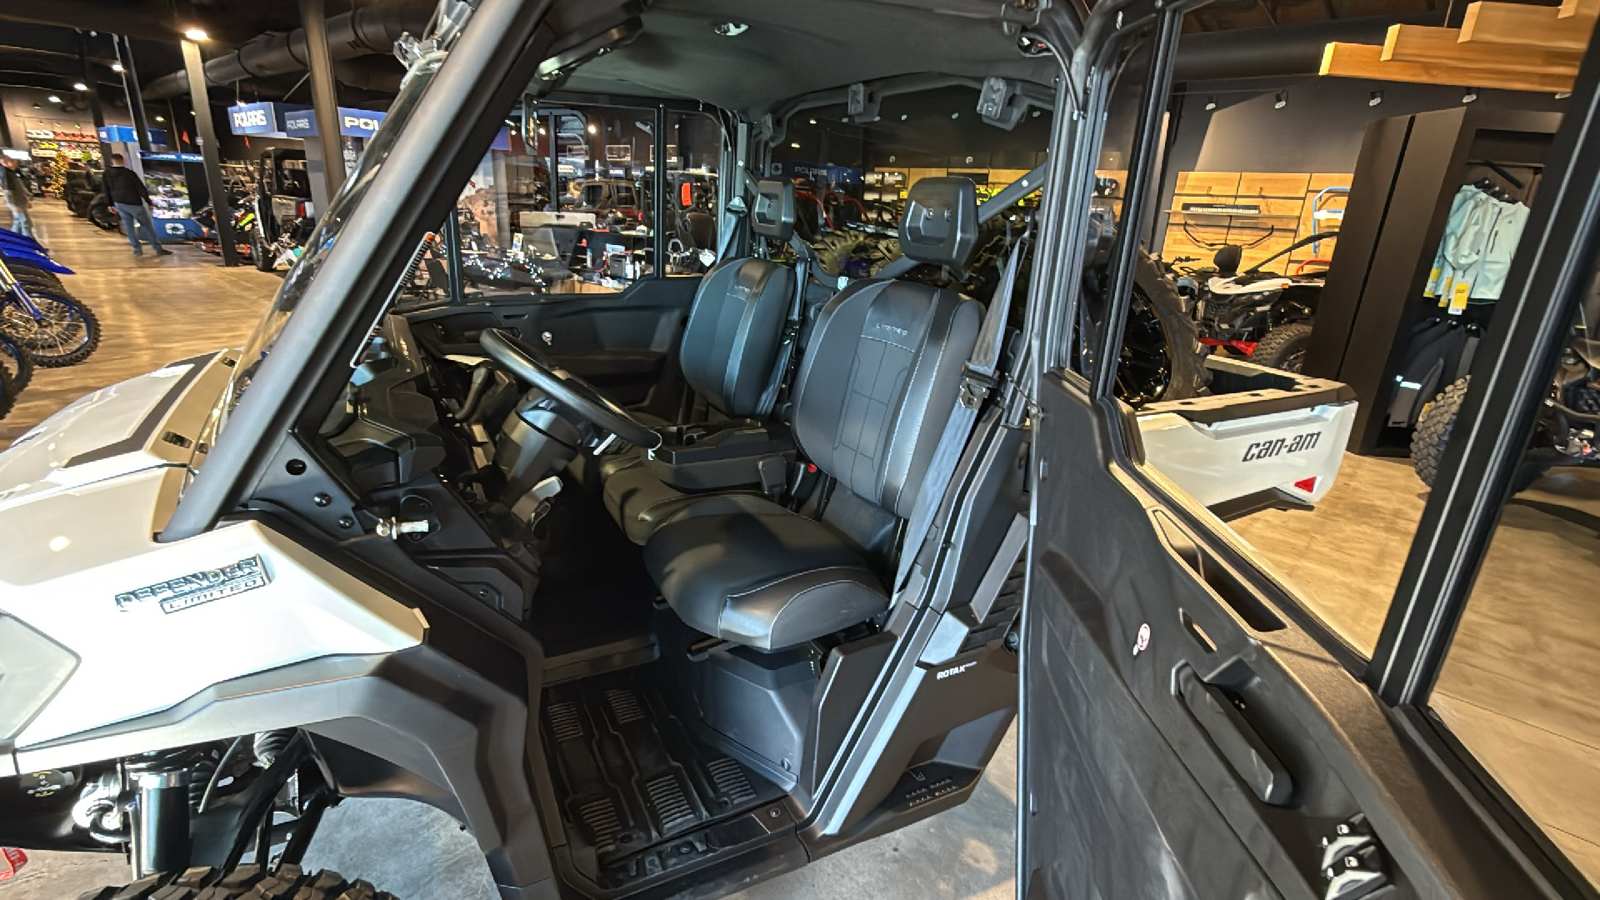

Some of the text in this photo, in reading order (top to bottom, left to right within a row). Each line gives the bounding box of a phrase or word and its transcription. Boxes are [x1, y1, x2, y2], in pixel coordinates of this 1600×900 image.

[233, 110, 267, 127] POLARIS
[1242, 431, 1322, 462] can-am
[115, 557, 260, 612] DEFENDER
[936, 664, 966, 680] ROTAX
